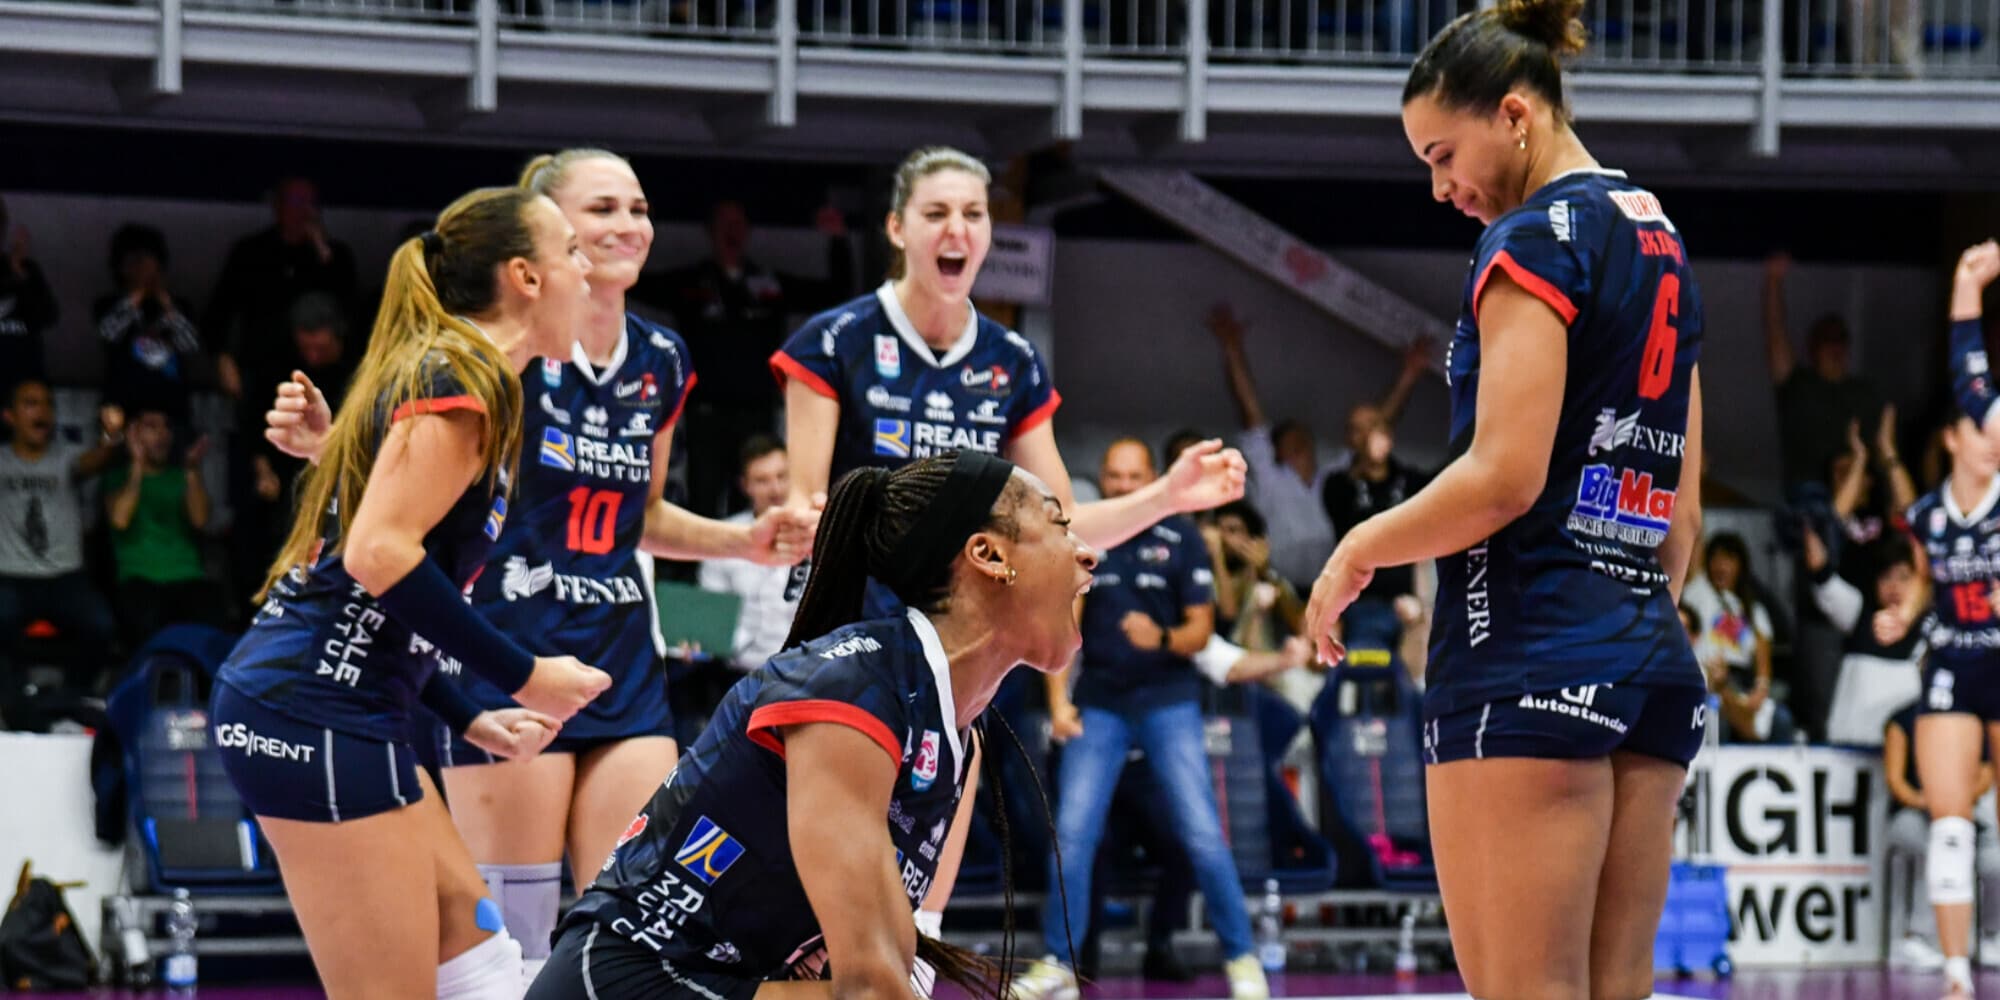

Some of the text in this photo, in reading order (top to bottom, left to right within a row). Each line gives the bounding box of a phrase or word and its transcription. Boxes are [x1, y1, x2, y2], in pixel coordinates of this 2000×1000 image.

[1638, 272, 1680, 400] 6
[575, 436, 650, 467] REALE
[913, 421, 1001, 454] REALE
[1630, 424, 1686, 457] ENER
[565, 486, 624, 555] 10
[1579, 463, 1677, 521] BigMa
[1467, 540, 1491, 648] ENERA
[1953, 581, 1991, 622] 15
[333, 606, 386, 688] EALE
[1696, 766, 1872, 856] IGH
[611, 870, 681, 936] MUTU
[901, 858, 933, 904] REA
[630, 883, 705, 951] REAL
[1727, 884, 1871, 943] wer
